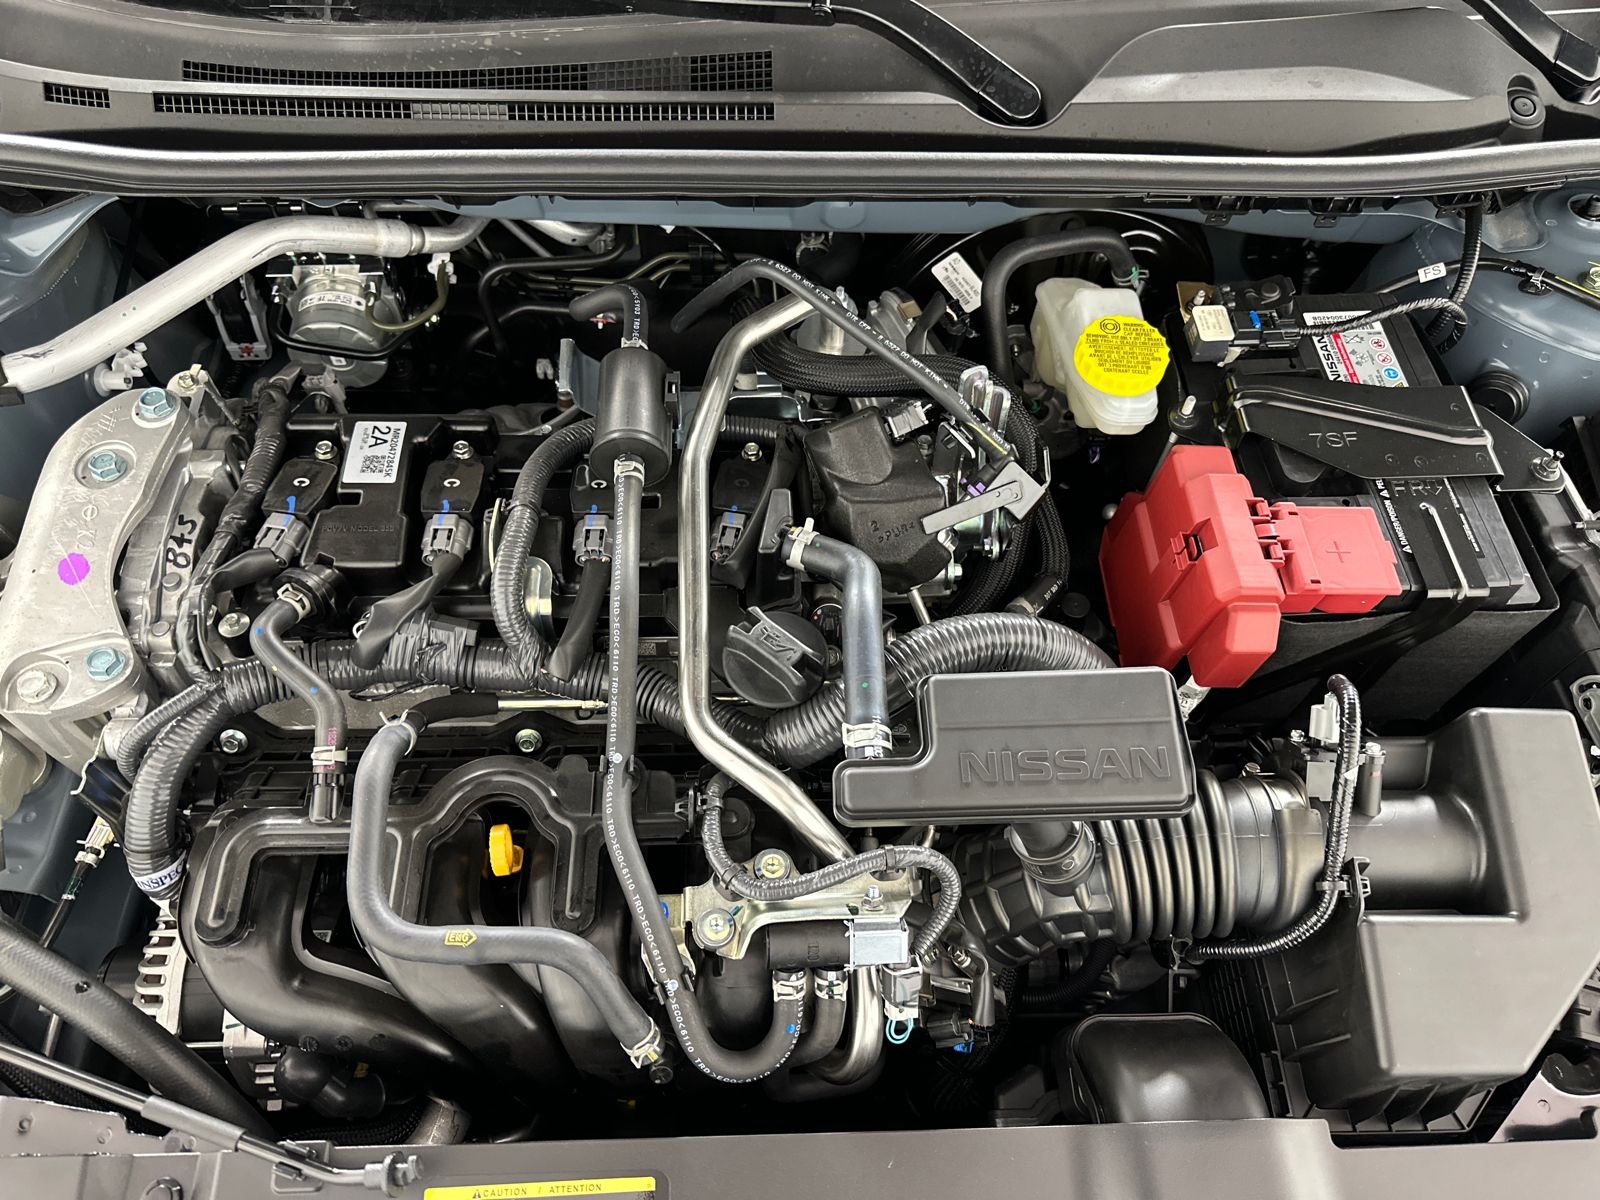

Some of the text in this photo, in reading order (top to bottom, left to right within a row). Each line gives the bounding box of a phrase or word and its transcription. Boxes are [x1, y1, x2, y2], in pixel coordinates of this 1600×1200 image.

[792, 272, 801, 280] DO
[1424, 266, 1441, 278] FS
[900, 351, 910, 359] DO
[910, 358, 923, 368] NOT
[925, 368, 941, 384] KINK
[368, 425, 391, 448] 2A
[1309, 431, 1357, 448] 7SF
[293, 478, 310, 487] C
[443, 478, 461, 488] C
[591, 480, 607, 488] C
[166, 514, 197, 568] 845
[612, 596, 621, 672] TRD>ECO<6110
[610, 677, 619, 742] TRD>ECO<6110
[959, 746, 1171, 783] NISSAN
[606, 818, 636, 890] TRD>ECO<6110
[449, 933, 469, 942] ENG
[632, 894, 667, 974] TRD>ECO<6110
[695, 1057, 770, 1083] TRD>ECO<6110
[483, 1188, 528, 1197] CAUTION
[549, 1183, 602, 1194] ATTENTION
